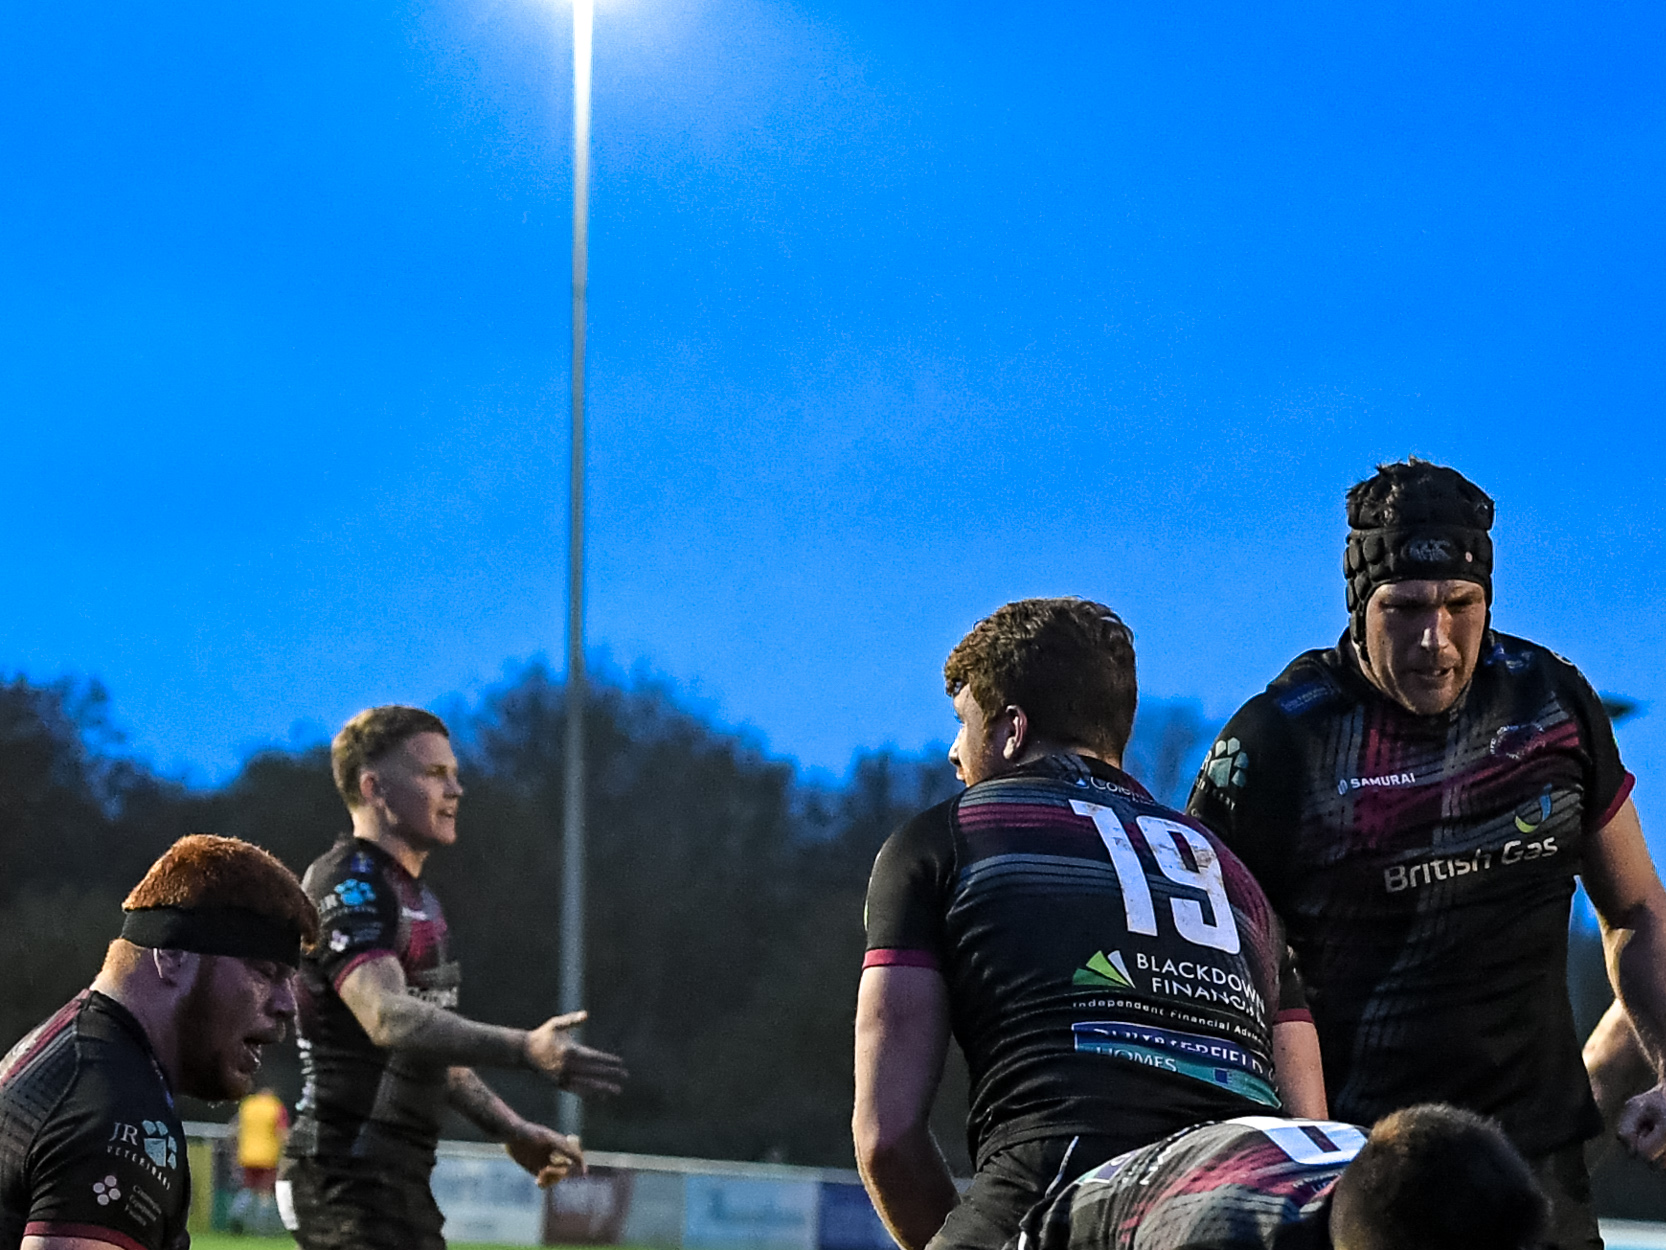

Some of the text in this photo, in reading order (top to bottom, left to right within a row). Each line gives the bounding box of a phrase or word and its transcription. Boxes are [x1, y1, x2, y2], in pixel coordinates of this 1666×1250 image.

[1350, 772, 1416, 790] SAMURAI
[1068, 799, 1241, 956] 19
[1384, 835, 1559, 894] British Gas
[1136, 952, 1266, 1015] BLACKDOWN
[109, 1122, 138, 1146] JR
